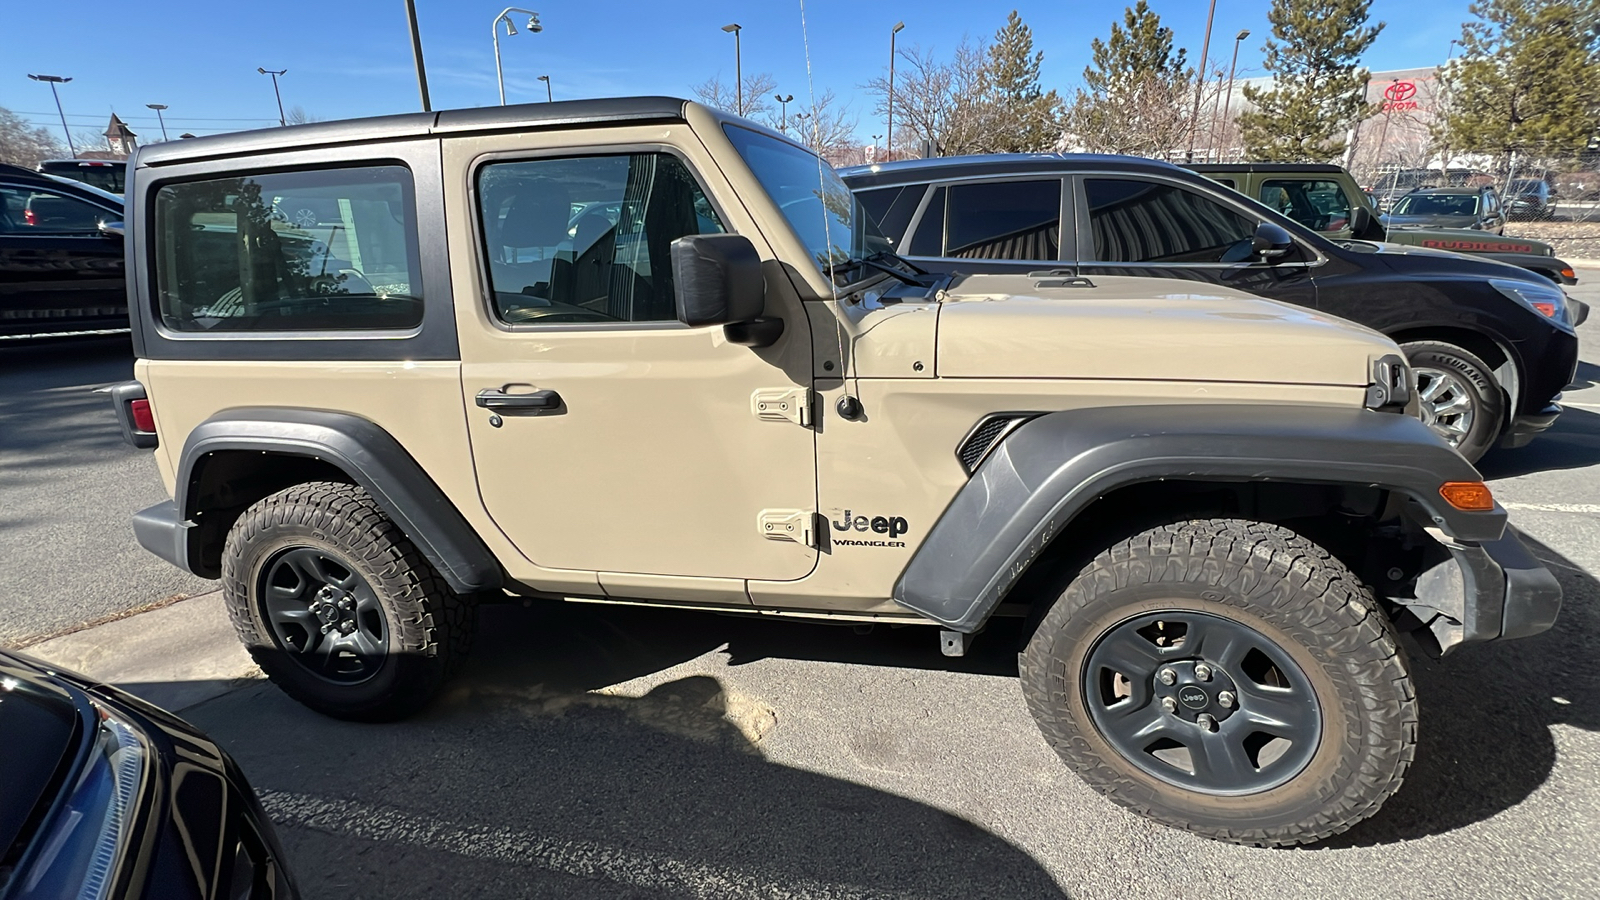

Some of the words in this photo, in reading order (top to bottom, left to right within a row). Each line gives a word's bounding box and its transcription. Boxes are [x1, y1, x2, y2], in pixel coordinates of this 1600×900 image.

[1381, 102, 1418, 111] OYOTA
[1422, 239, 1532, 252] RUBICON
[1432, 354, 1487, 391] ASSURANCE
[832, 510, 908, 538] Jeep
[1182, 694, 1205, 702] Jeep
